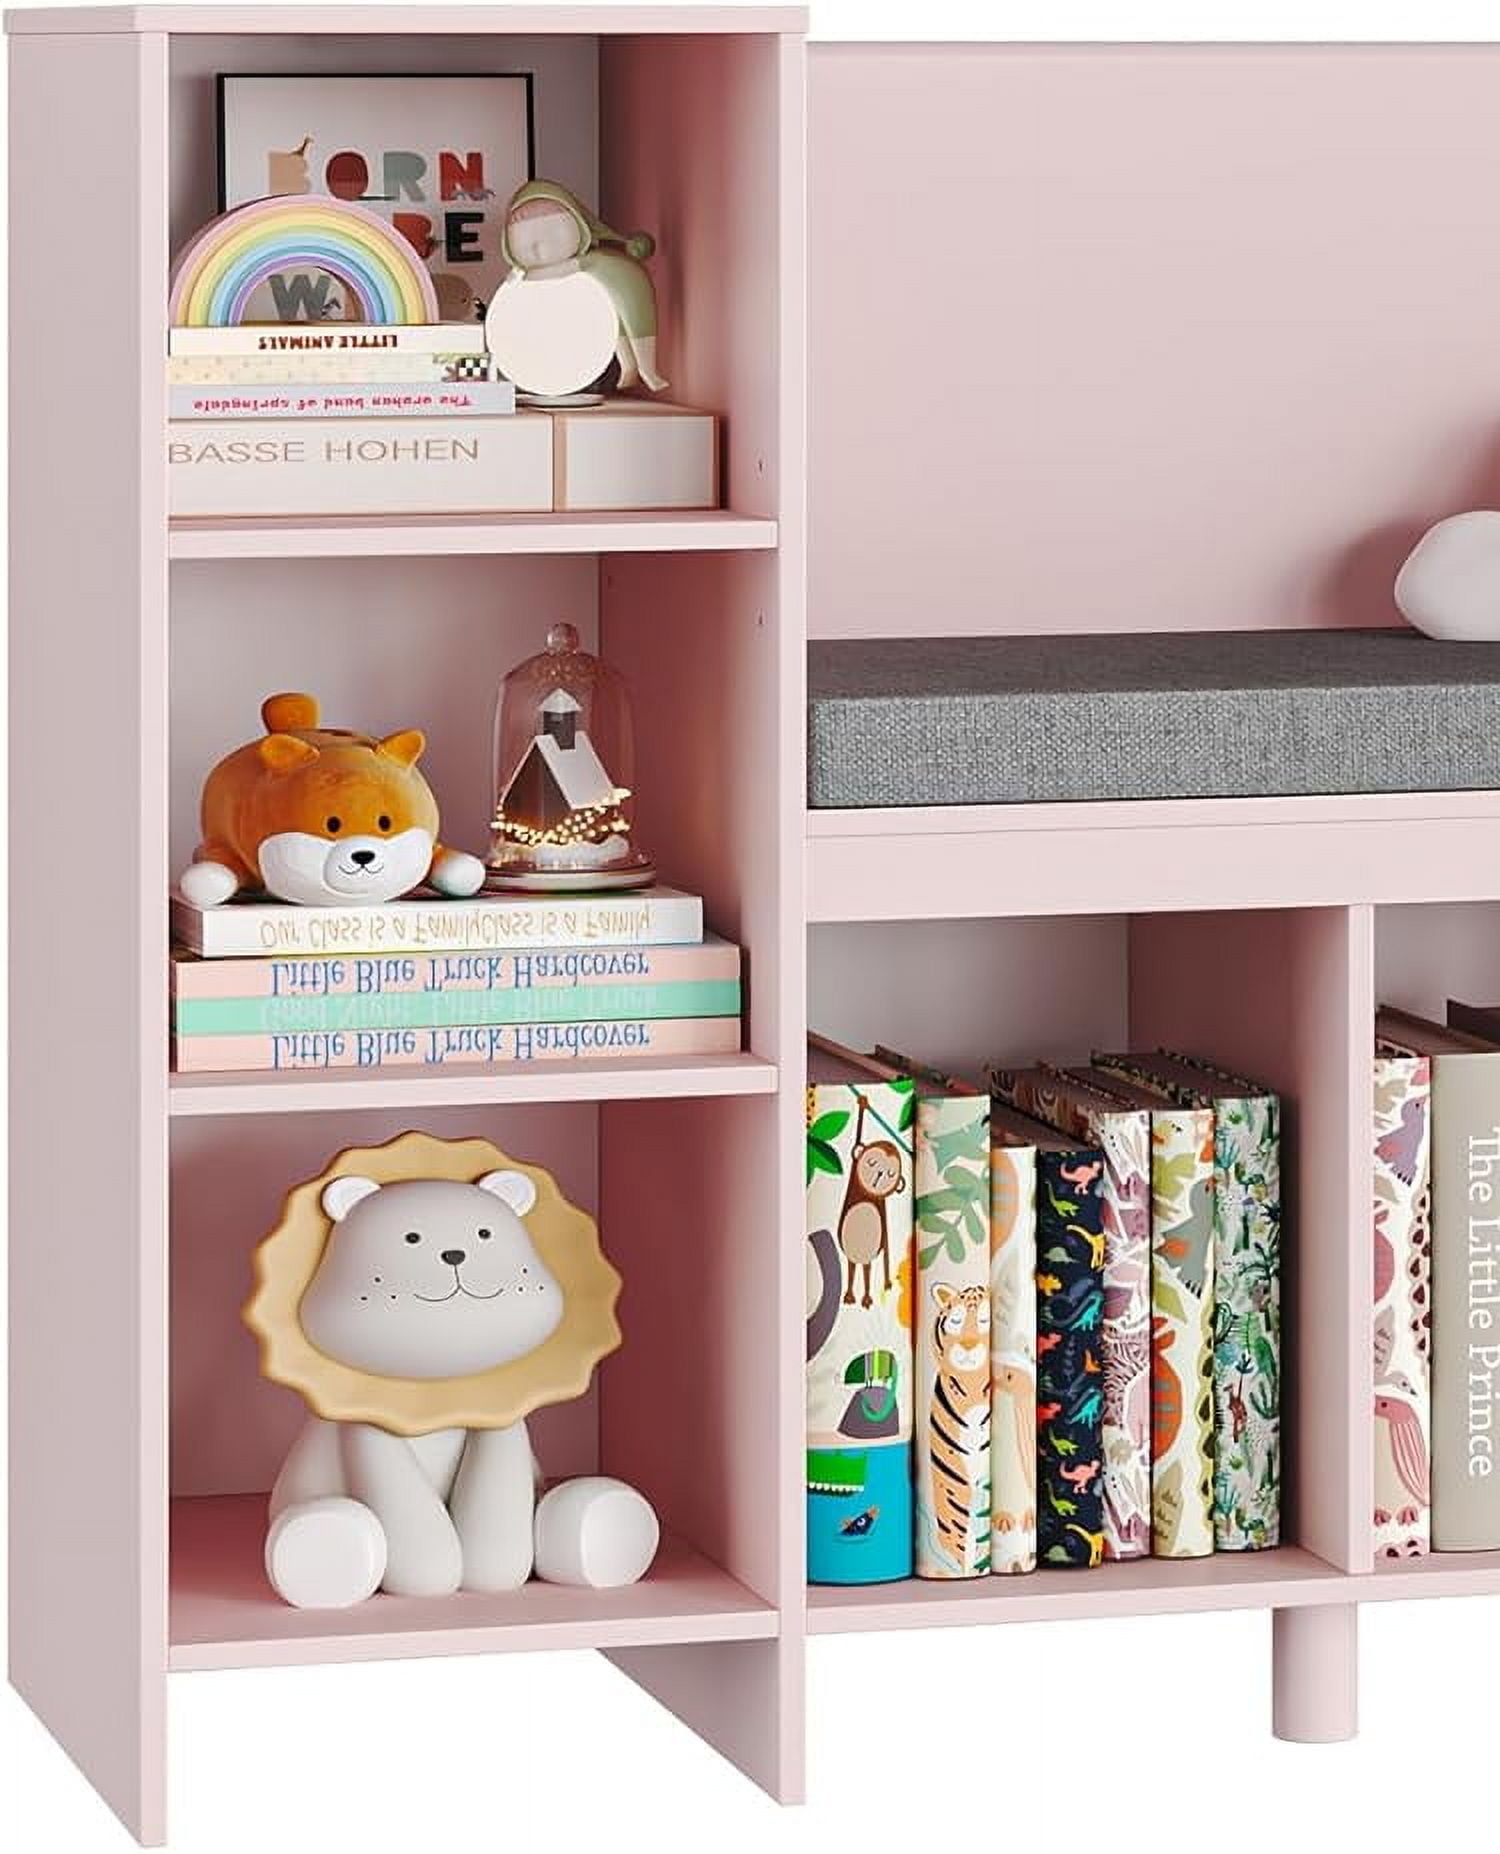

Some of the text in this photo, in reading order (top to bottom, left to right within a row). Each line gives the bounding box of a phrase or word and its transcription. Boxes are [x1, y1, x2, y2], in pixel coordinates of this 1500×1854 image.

[268, 151, 484, 201] BORN
[393, 212, 484, 262] BE
[257, 334, 398, 349] LITTLE ANIMALS
[168, 439, 479, 464] BASSE HOHEN
